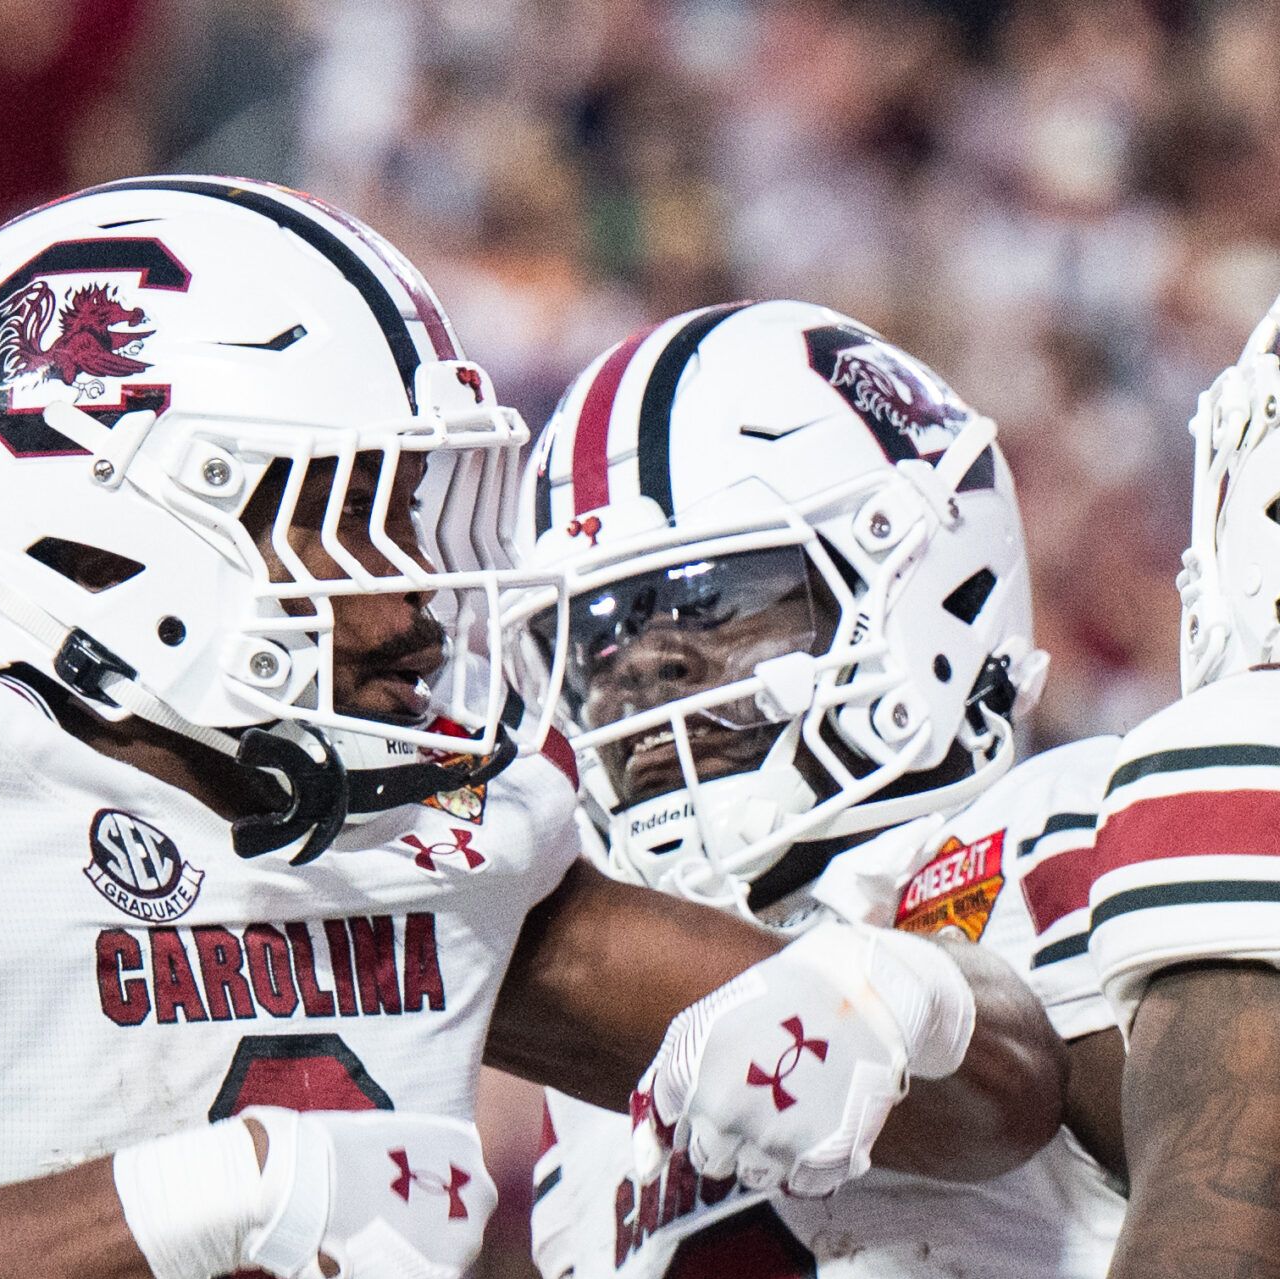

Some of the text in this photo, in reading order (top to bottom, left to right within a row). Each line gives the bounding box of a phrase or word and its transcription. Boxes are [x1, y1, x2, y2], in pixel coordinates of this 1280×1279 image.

[96, 812, 175, 891] SEC
[104, 882, 193, 919] GRADUATE
[95, 912, 446, 1027] CAROLINA
